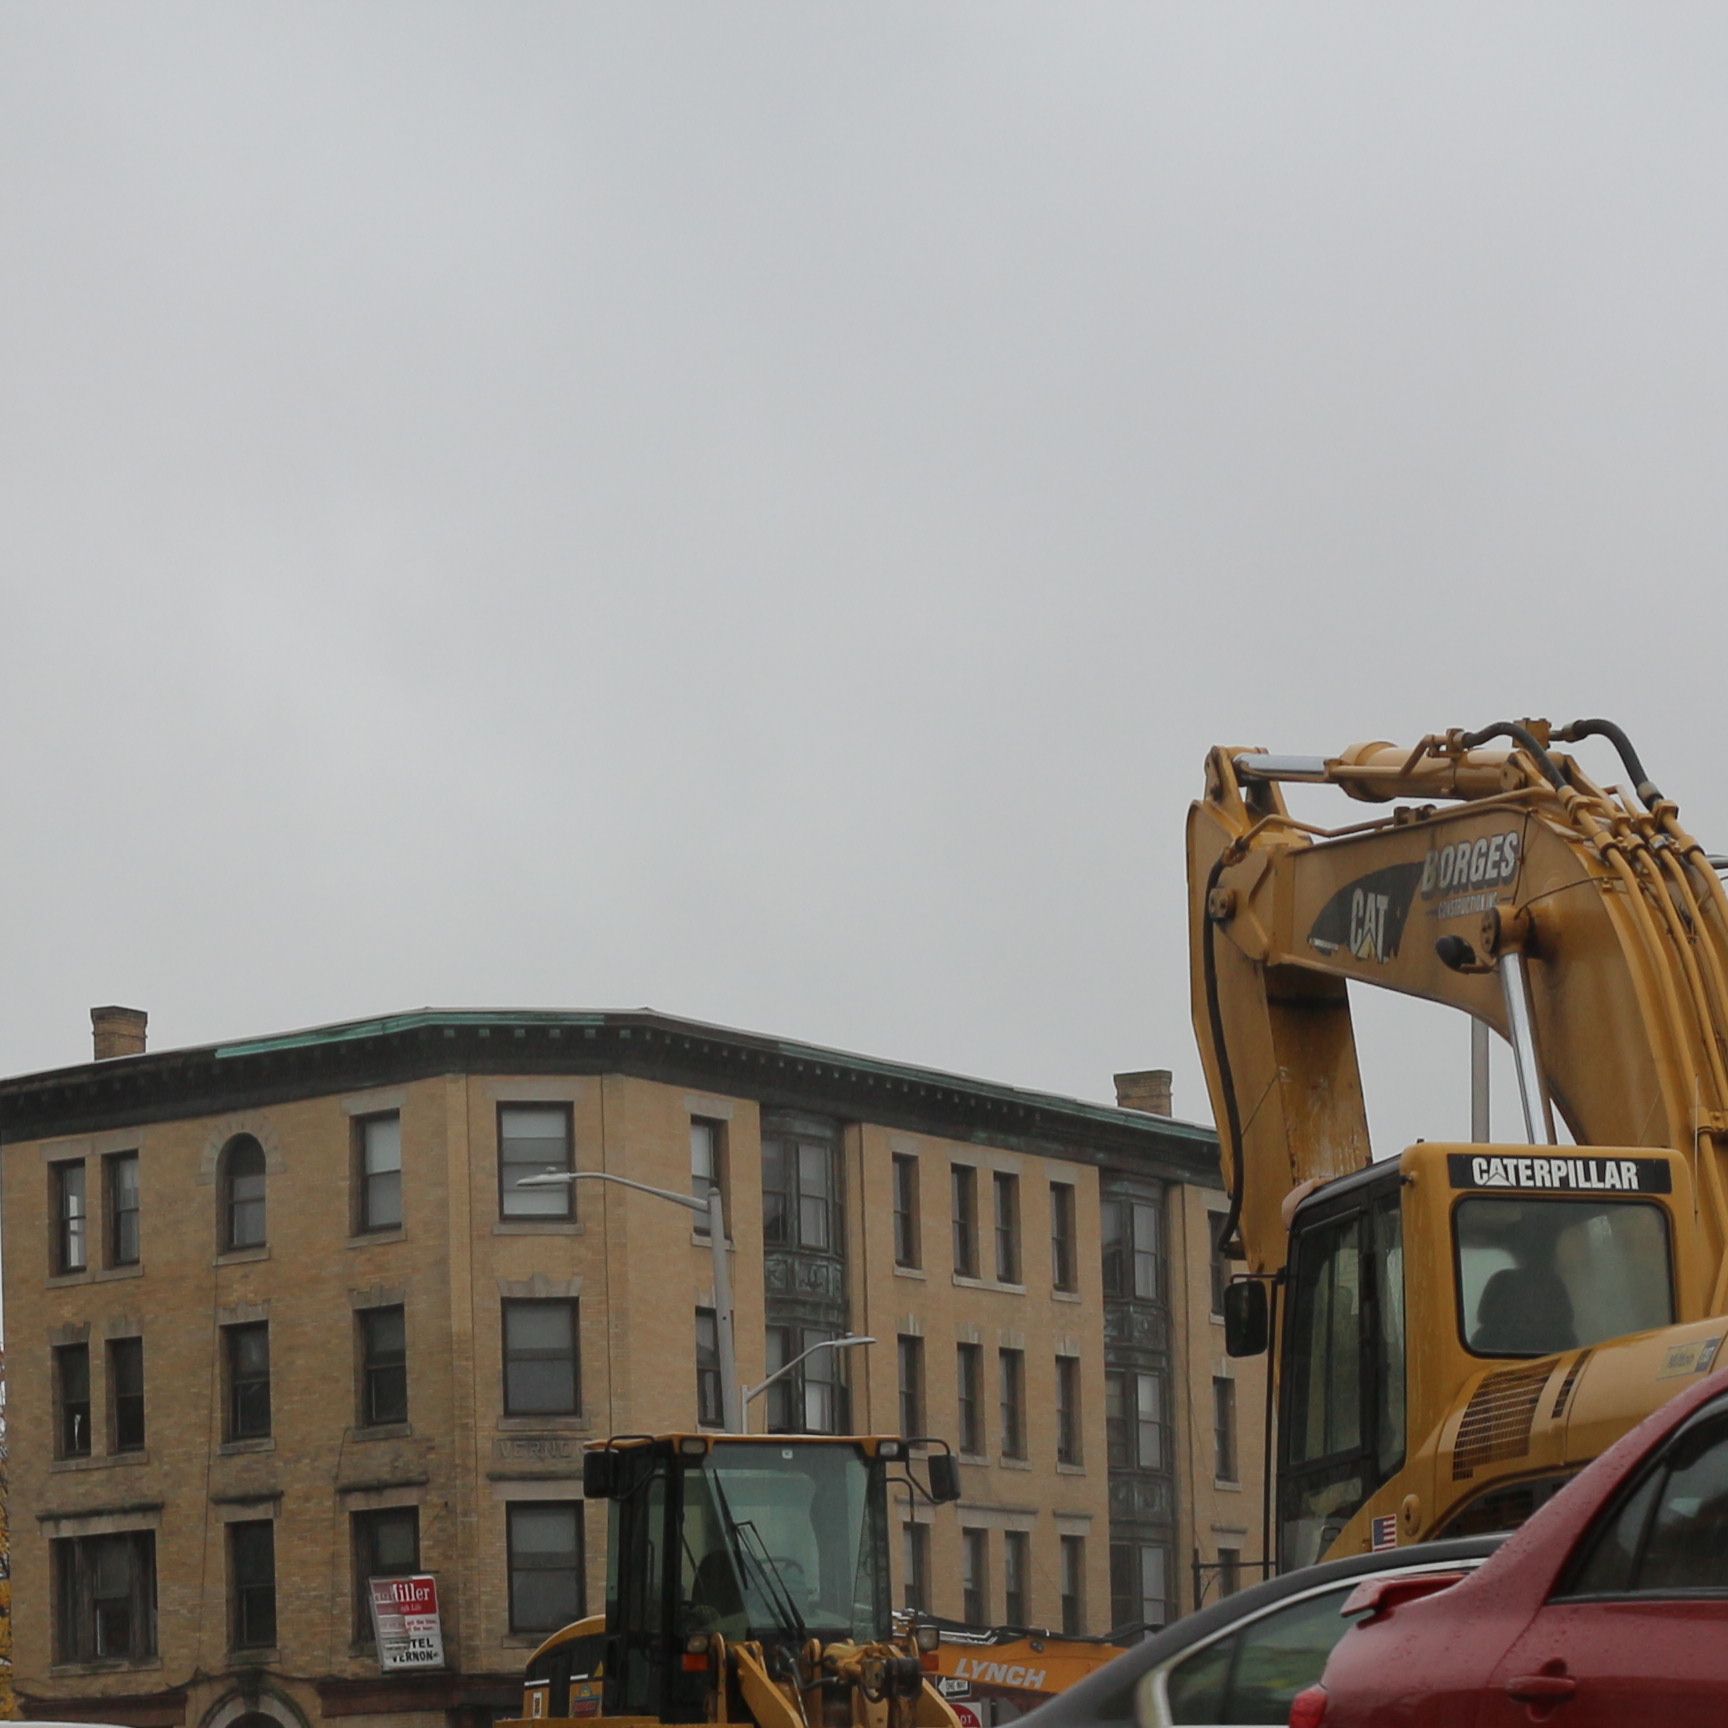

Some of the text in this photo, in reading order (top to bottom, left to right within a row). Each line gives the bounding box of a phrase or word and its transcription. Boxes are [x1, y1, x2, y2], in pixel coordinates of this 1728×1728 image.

[1422, 831, 1519, 892] BORGES
[1350, 887, 1389, 962] CAT
[1472, 1157, 1639, 1190] CATERPILLAR
[410, 1638, 433, 1649] TEL
[954, 1658, 1047, 1689] LYNCH
